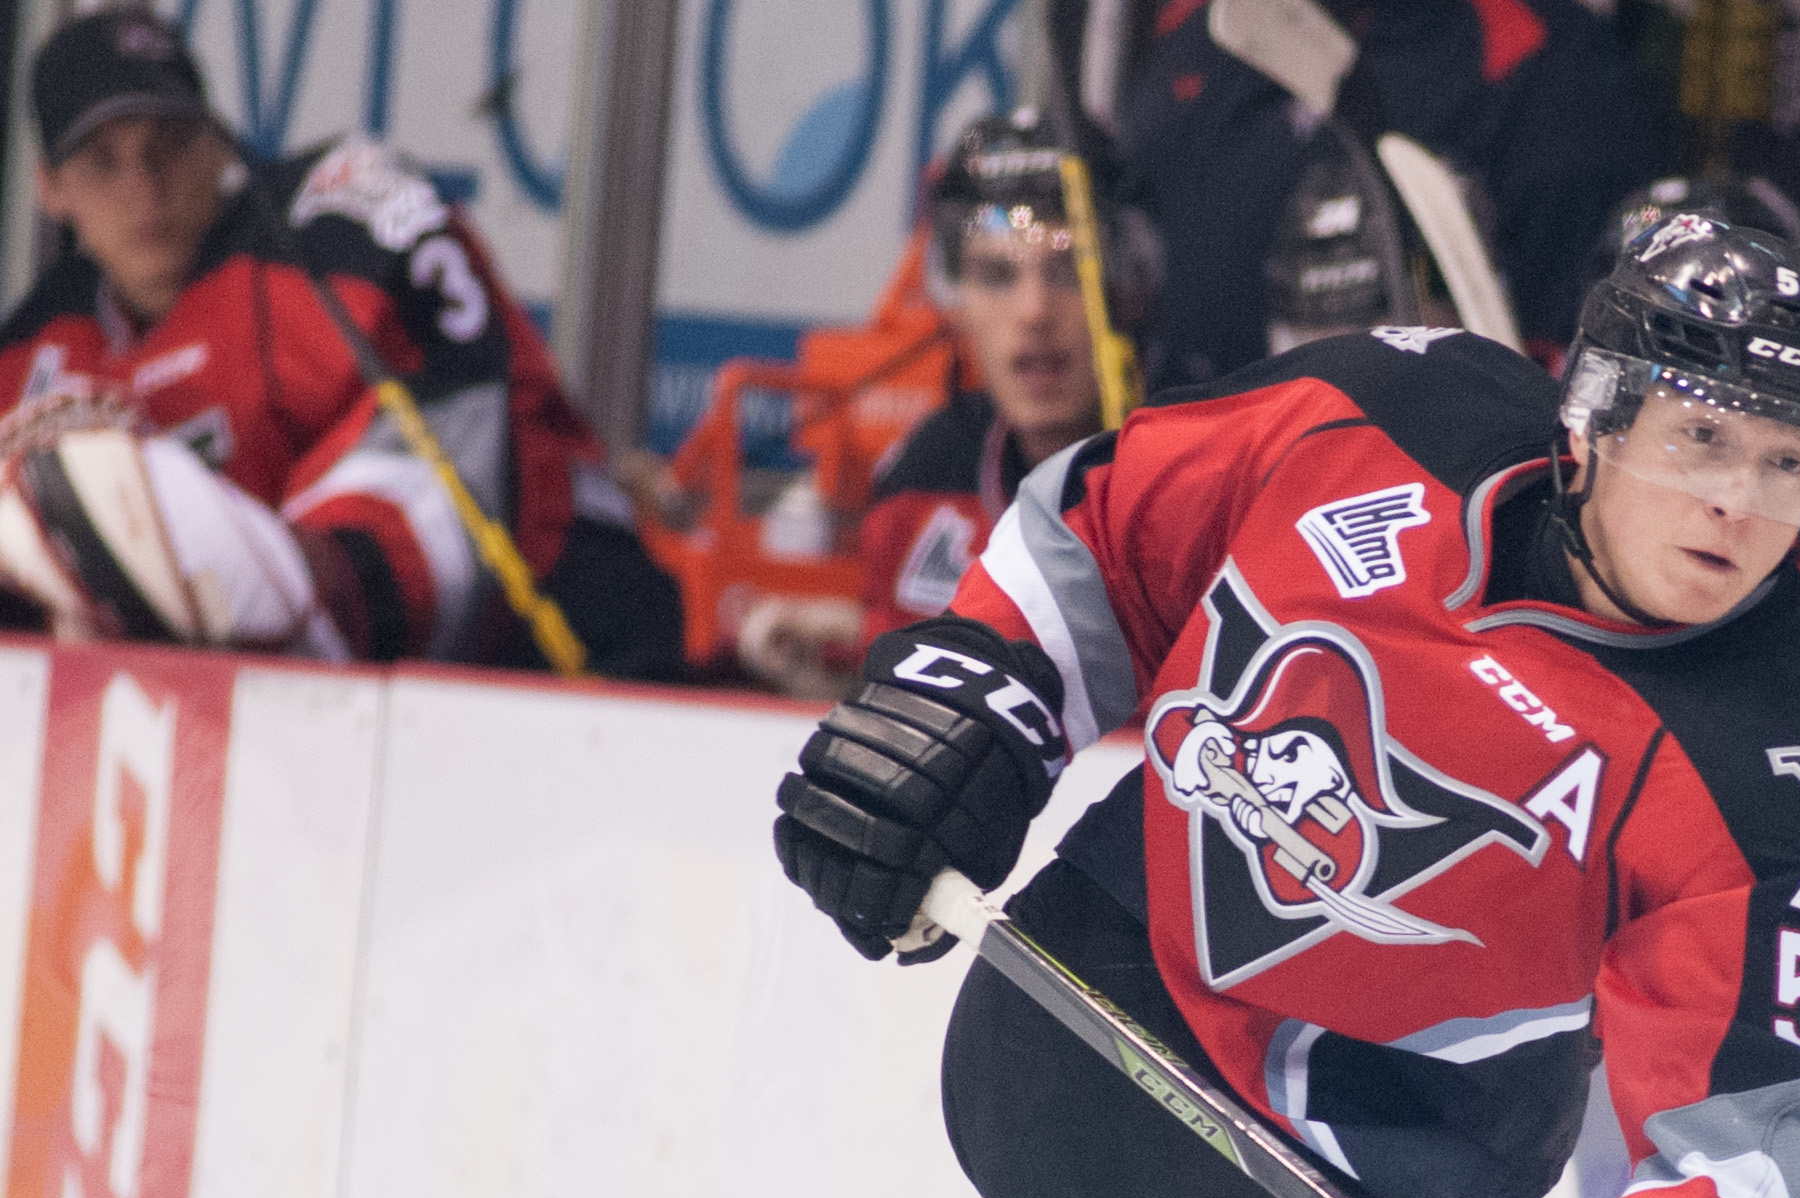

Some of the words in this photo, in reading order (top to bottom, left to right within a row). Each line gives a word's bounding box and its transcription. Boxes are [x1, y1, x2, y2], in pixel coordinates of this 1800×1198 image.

[893, 643, 1064, 770] CC
[1469, 654, 1576, 743] CCM
[1524, 748, 1603, 863] A
[1134, 1068, 1219, 1139] CCM
